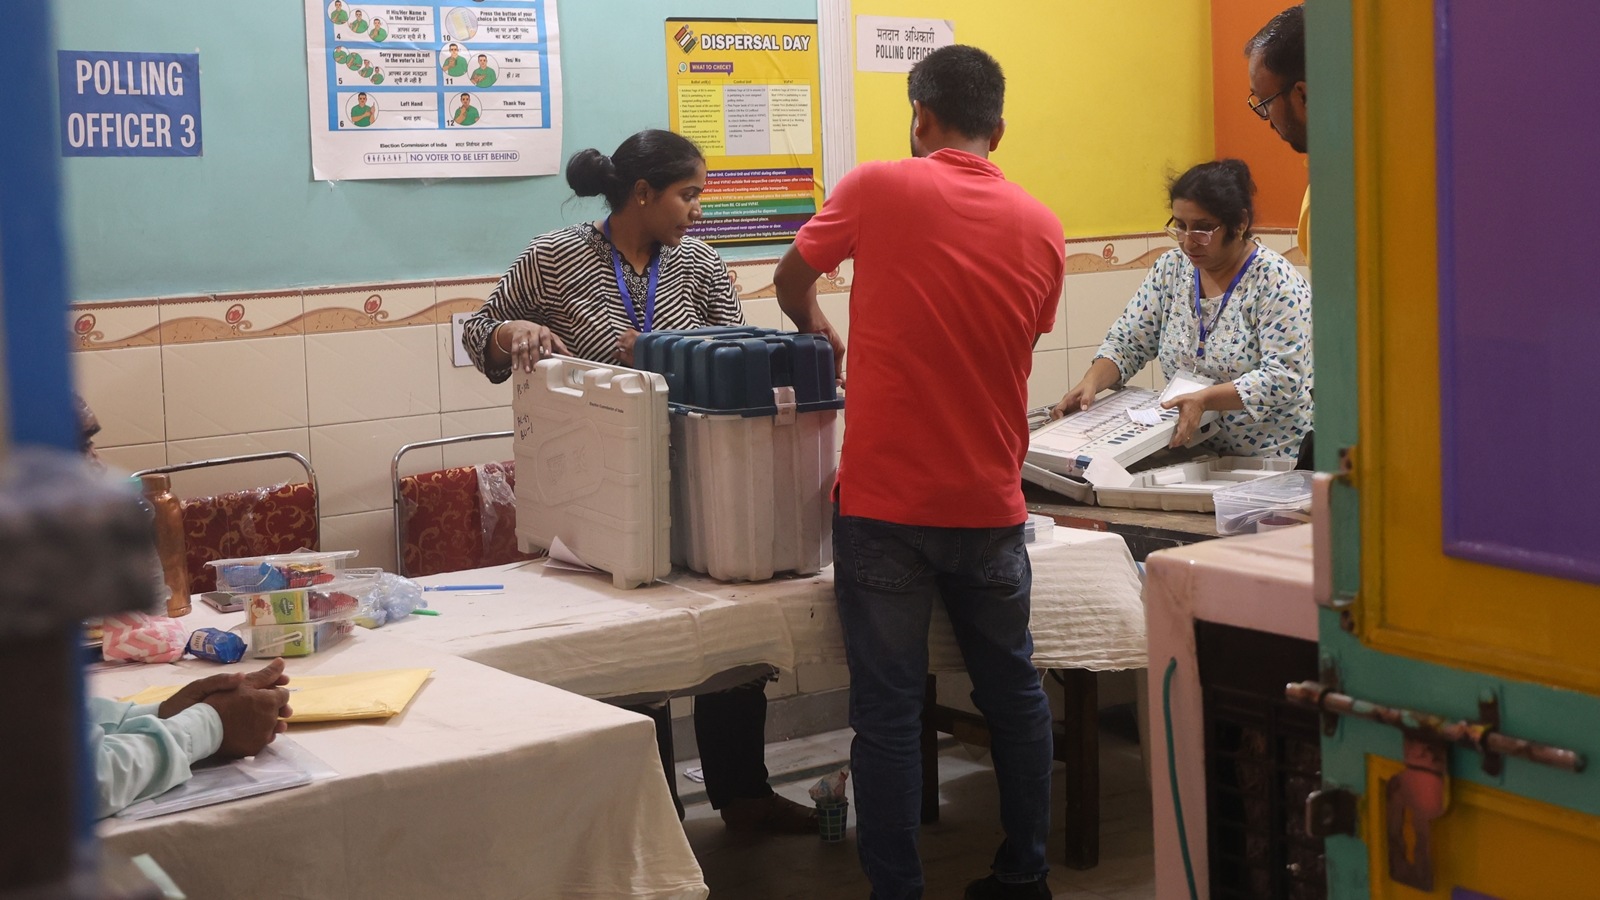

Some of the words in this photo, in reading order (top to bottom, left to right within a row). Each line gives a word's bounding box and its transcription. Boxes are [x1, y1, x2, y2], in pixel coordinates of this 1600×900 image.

[701, 34, 780, 51] DISPERSAL
[783, 36, 810, 51] DAY
[876, 28, 899, 43] मतदान
[904, 26, 935, 43] अधिकारी
[876, 44, 904, 59] POLLING
[76, 60, 183, 96] POLLING
[68, 113, 172, 148] OFFICER
[180, 114, 196, 148] 3
